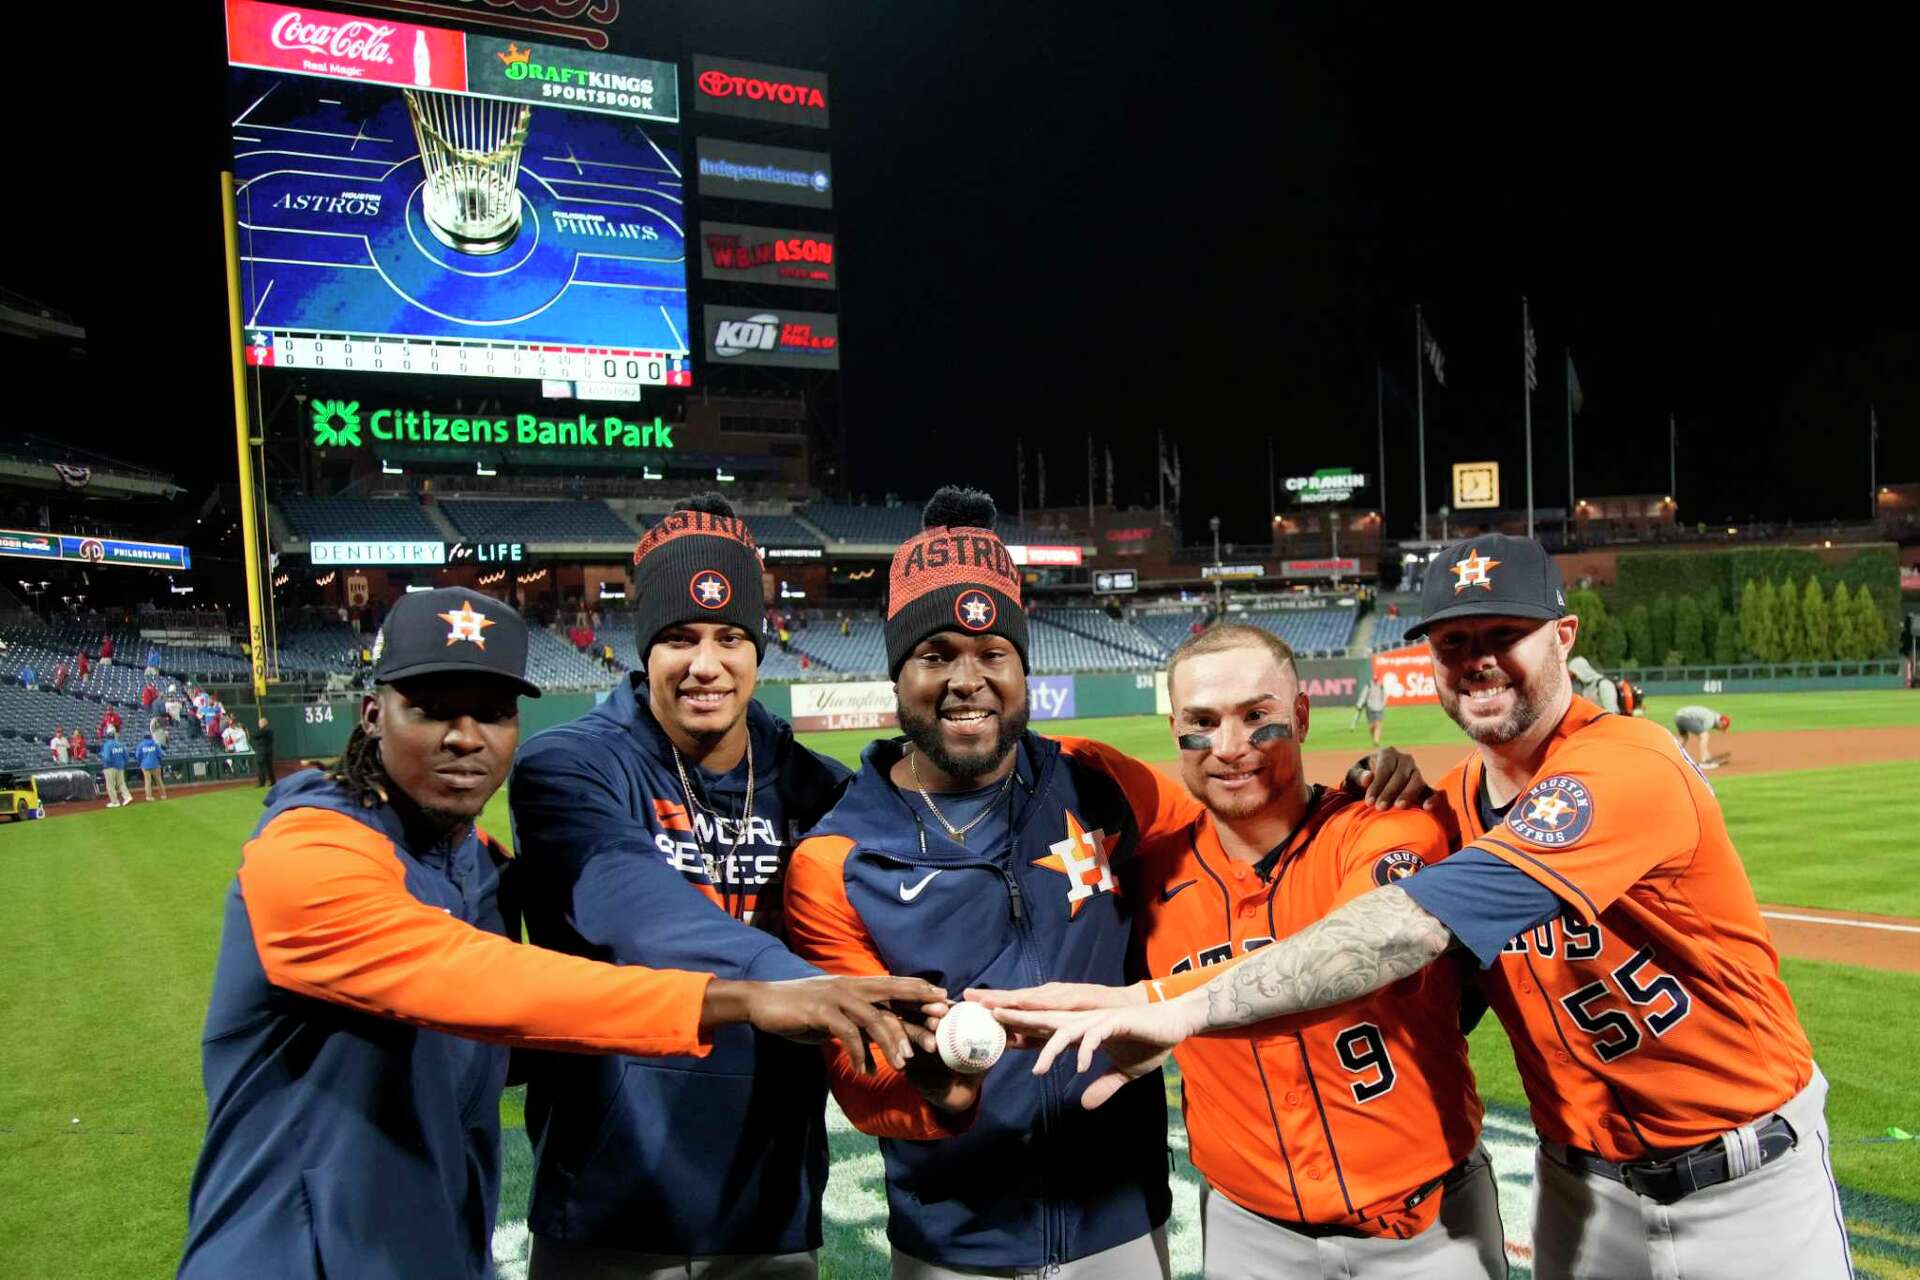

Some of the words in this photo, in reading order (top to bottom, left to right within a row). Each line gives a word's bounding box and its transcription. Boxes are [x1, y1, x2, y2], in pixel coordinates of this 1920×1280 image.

[271, 12, 396, 63] Coca-Cola
[303, 60, 328, 72] Real
[330, 64, 363, 76] Magic
[542, 84, 653, 110] SPORTSBOOK
[731, 76, 825, 108] TOYOTA
[272, 193, 380, 216] ASTROS
[555, 218, 659, 240] PHILLIES
[604, 359, 616, 378] 0
[626, 361, 638, 379] 0
[648, 362, 660, 380] 0
[370, 409, 509, 443] Citizens
[516, 414, 599, 445] Bank
[604, 417, 674, 448] Park
[113, 548, 171, 560] PHILADELPHIA
[313, 545, 440, 561] DENTISTRY
[449, 542, 473, 560] for
[478, 544, 522, 561] LIFE
[304, 706, 334, 724] 334
[826, 713, 881, 730] LAGER
[1528, 776, 1589, 808] HOUSTON
[1511, 818, 1565, 842] ASTROS
[1560, 945, 1692, 1064] 55
[1334, 1021, 1397, 1105] 9
